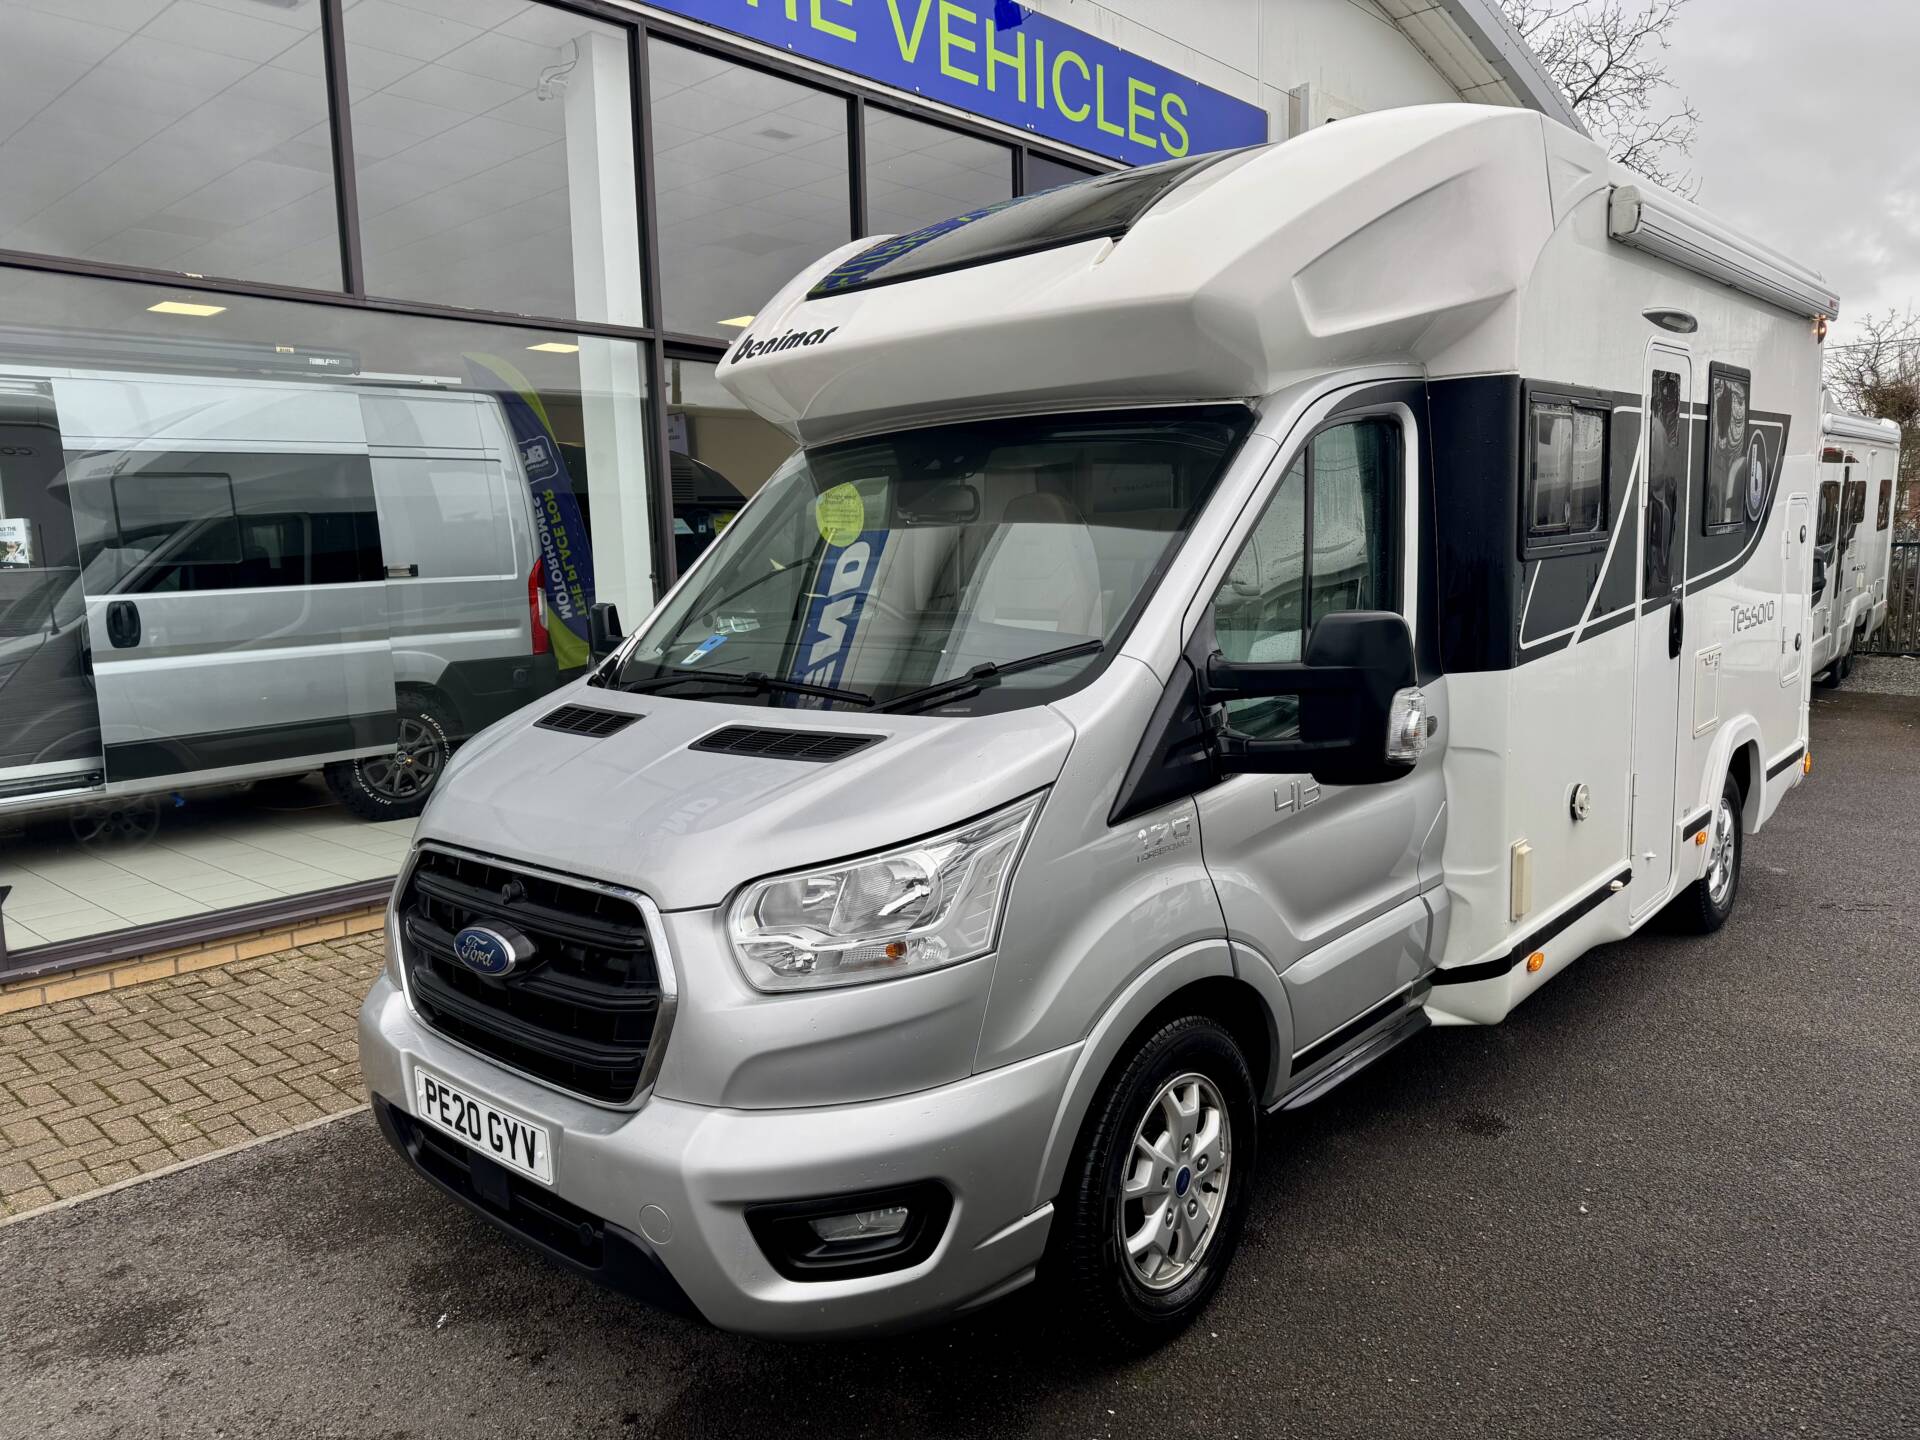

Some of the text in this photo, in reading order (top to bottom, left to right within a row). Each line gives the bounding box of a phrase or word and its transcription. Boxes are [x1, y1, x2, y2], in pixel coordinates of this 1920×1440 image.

[887, 0, 1190, 157] VEHICLES
[462, 935, 496, 967] Ford
[424, 1077, 482, 1142] PE20
[487, 1111, 536, 1169] GYV
